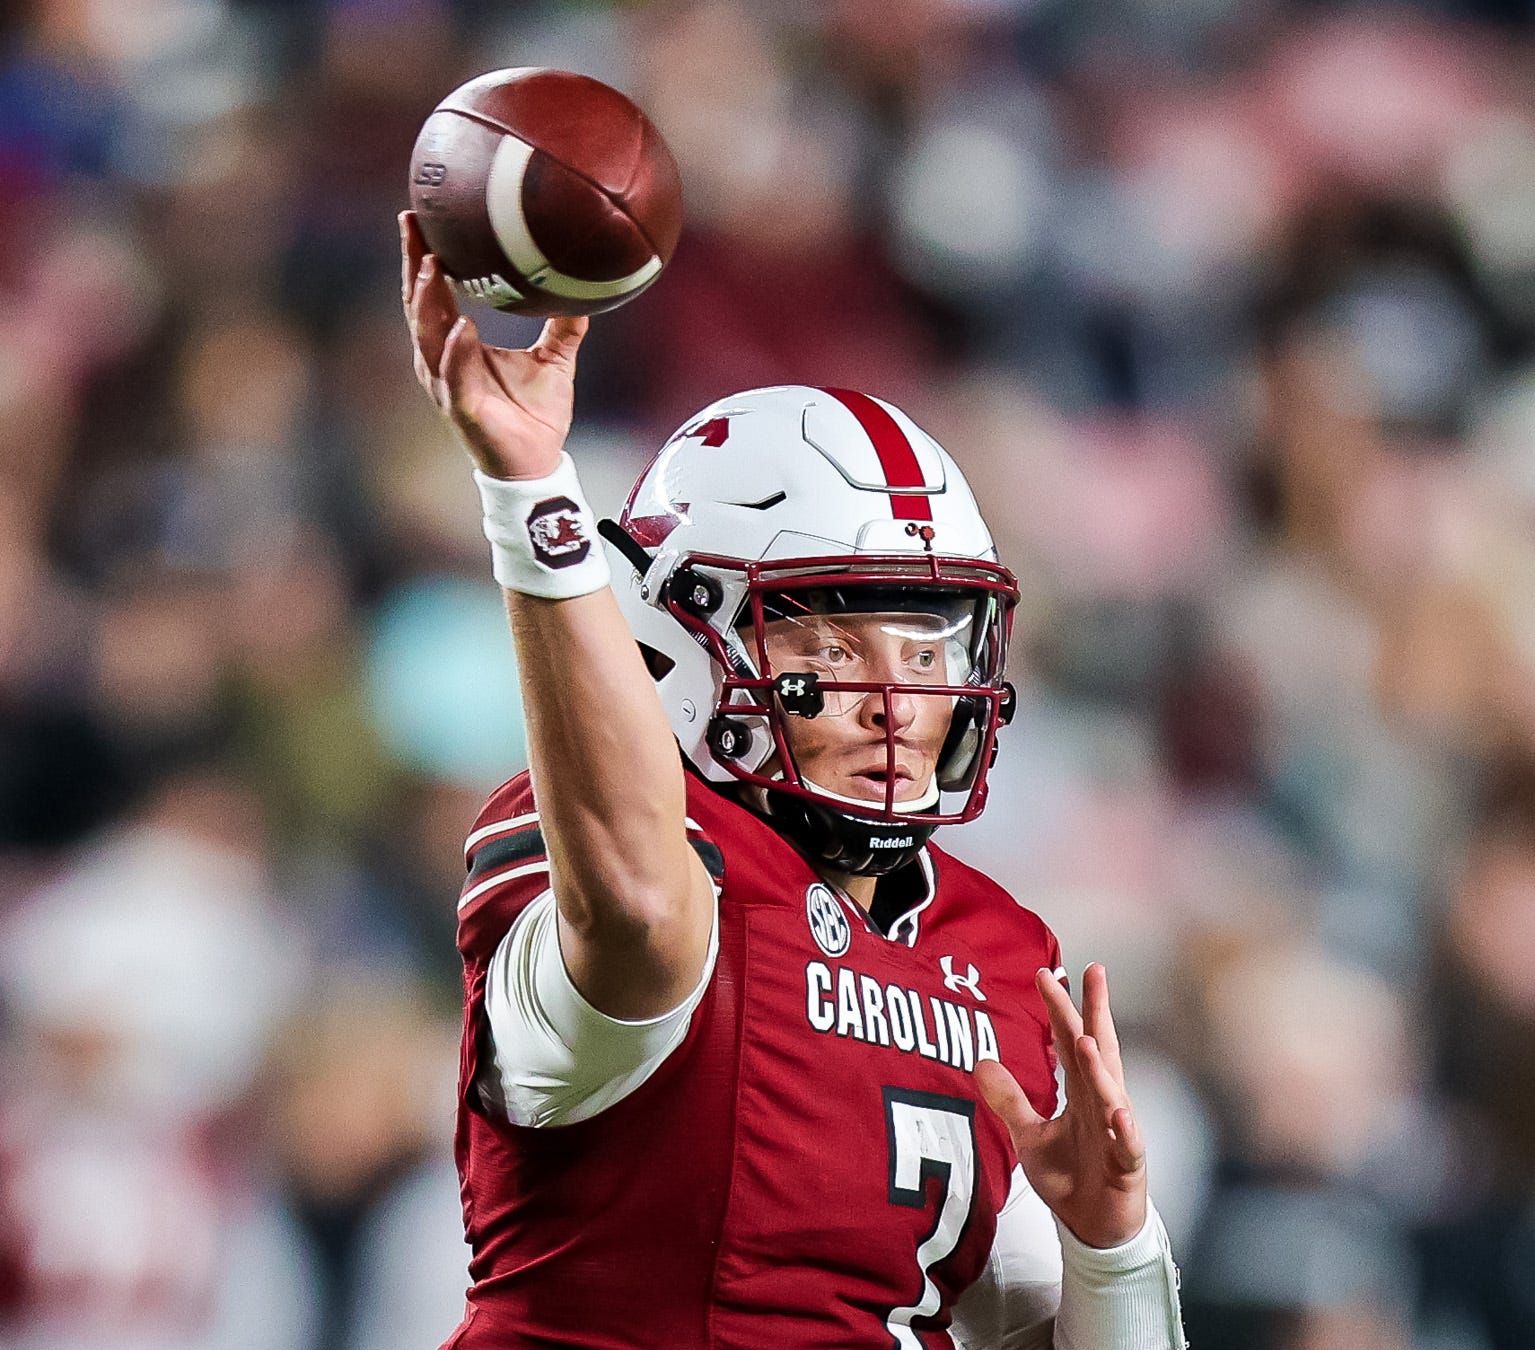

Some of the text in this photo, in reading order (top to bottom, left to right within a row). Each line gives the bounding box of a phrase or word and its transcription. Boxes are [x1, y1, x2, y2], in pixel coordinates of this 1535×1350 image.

[869, 836, 913, 849] Riddell
[808, 885, 850, 955] SEC
[805, 960, 1000, 1073] CAROLINA
